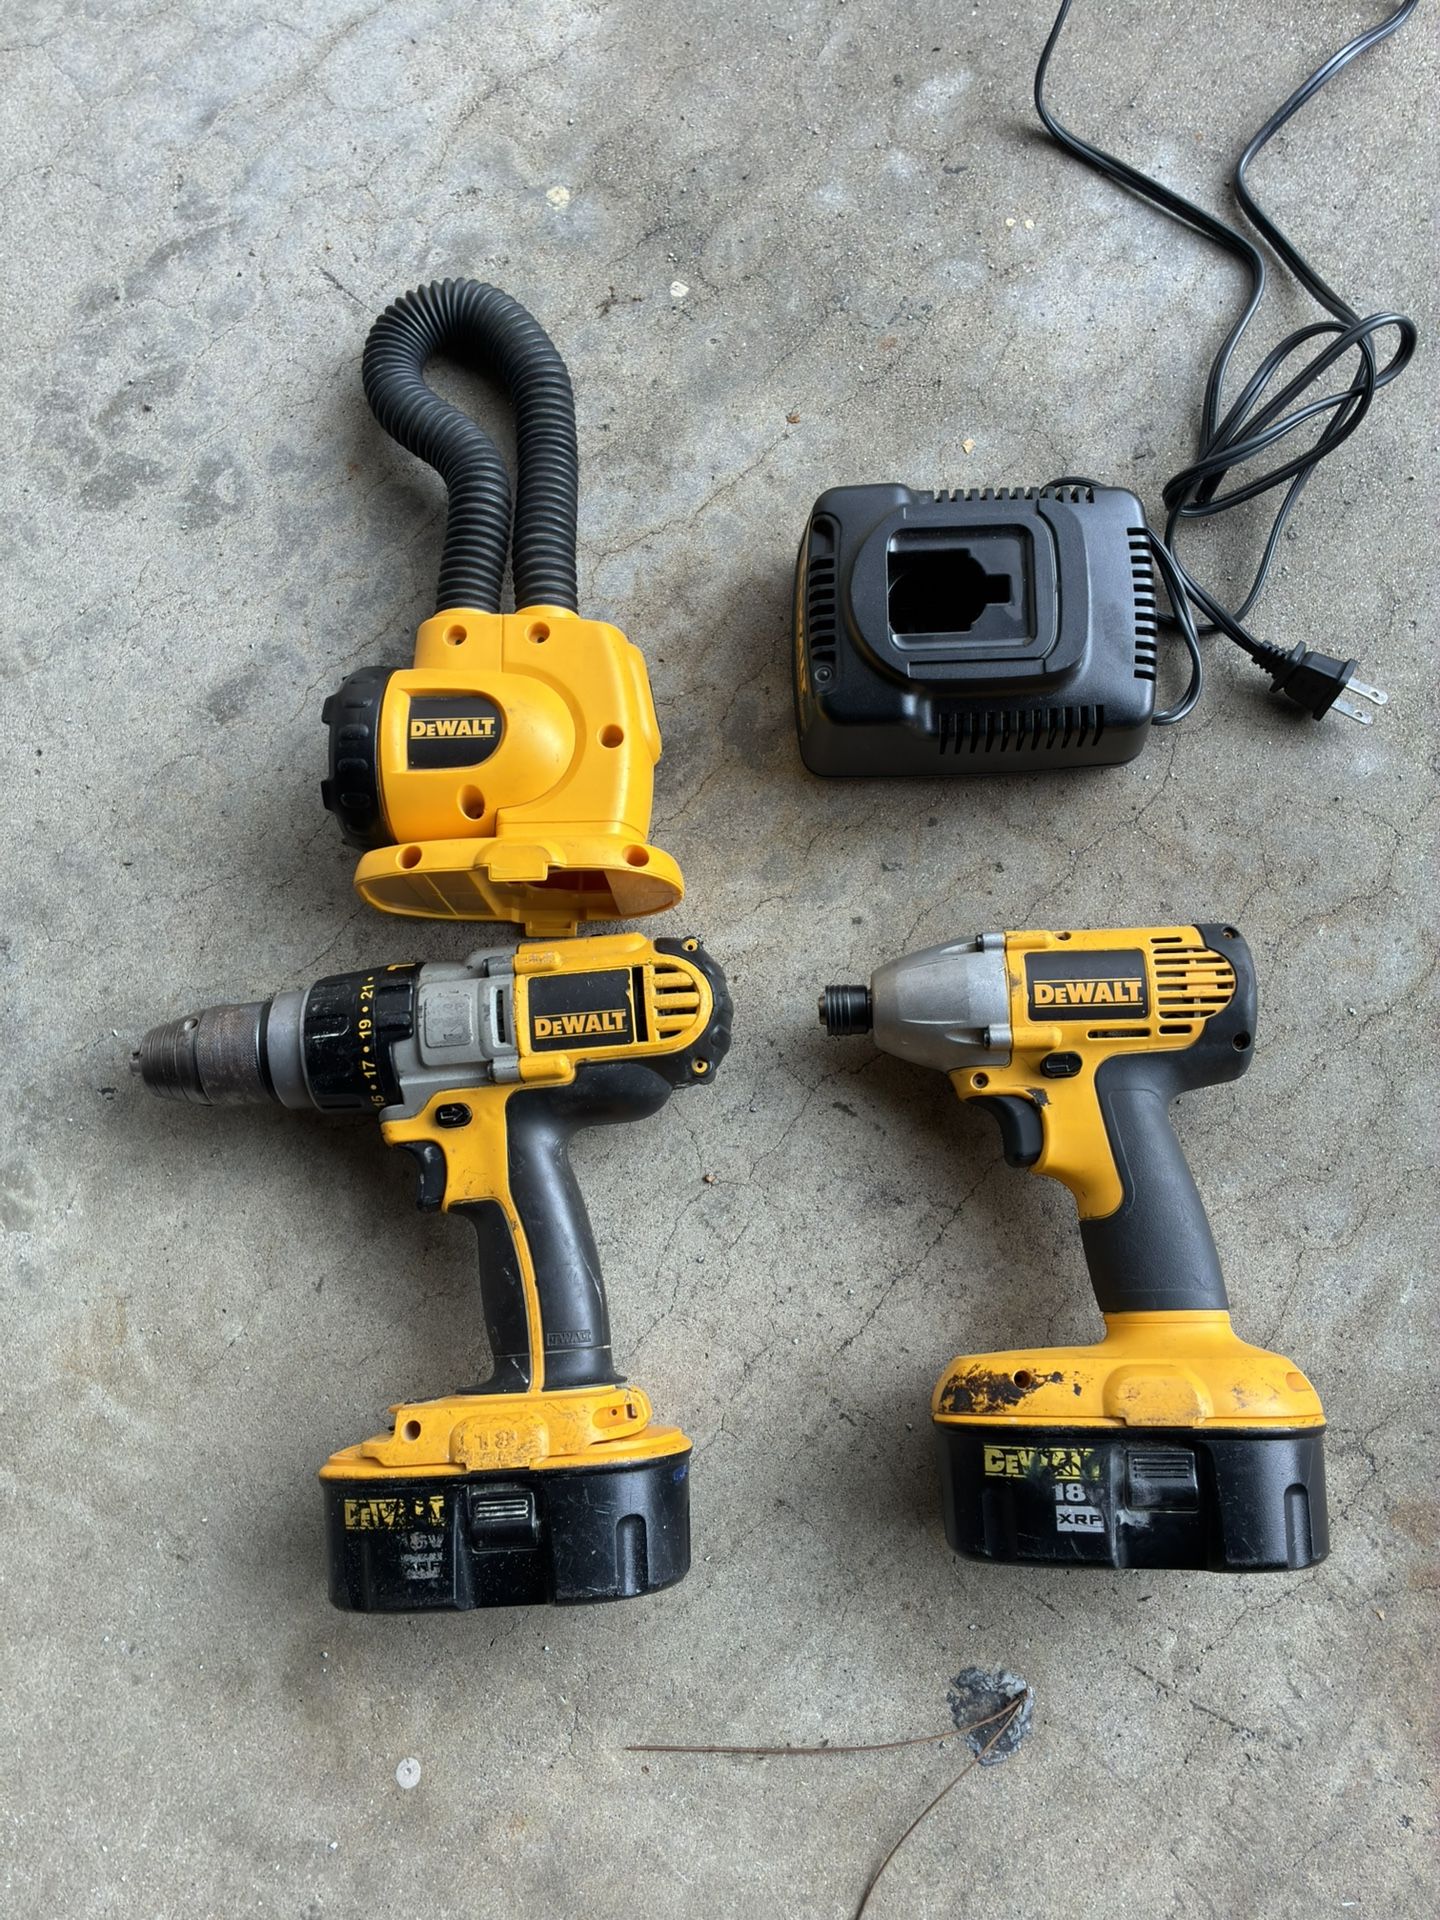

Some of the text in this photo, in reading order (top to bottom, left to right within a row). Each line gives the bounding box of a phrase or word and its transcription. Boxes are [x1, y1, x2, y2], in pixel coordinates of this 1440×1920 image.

[410, 719, 495, 737] DEWALT
[360, 983, 375, 1000] 21
[1033, 981, 1143, 1005] DEWALT
[358, 1018, 373, 1039] 19
[534, 1011, 627, 1037] DEWALT
[361, 1060, 377, 1079] 17
[1058, 1513, 1103, 1525] XRP
